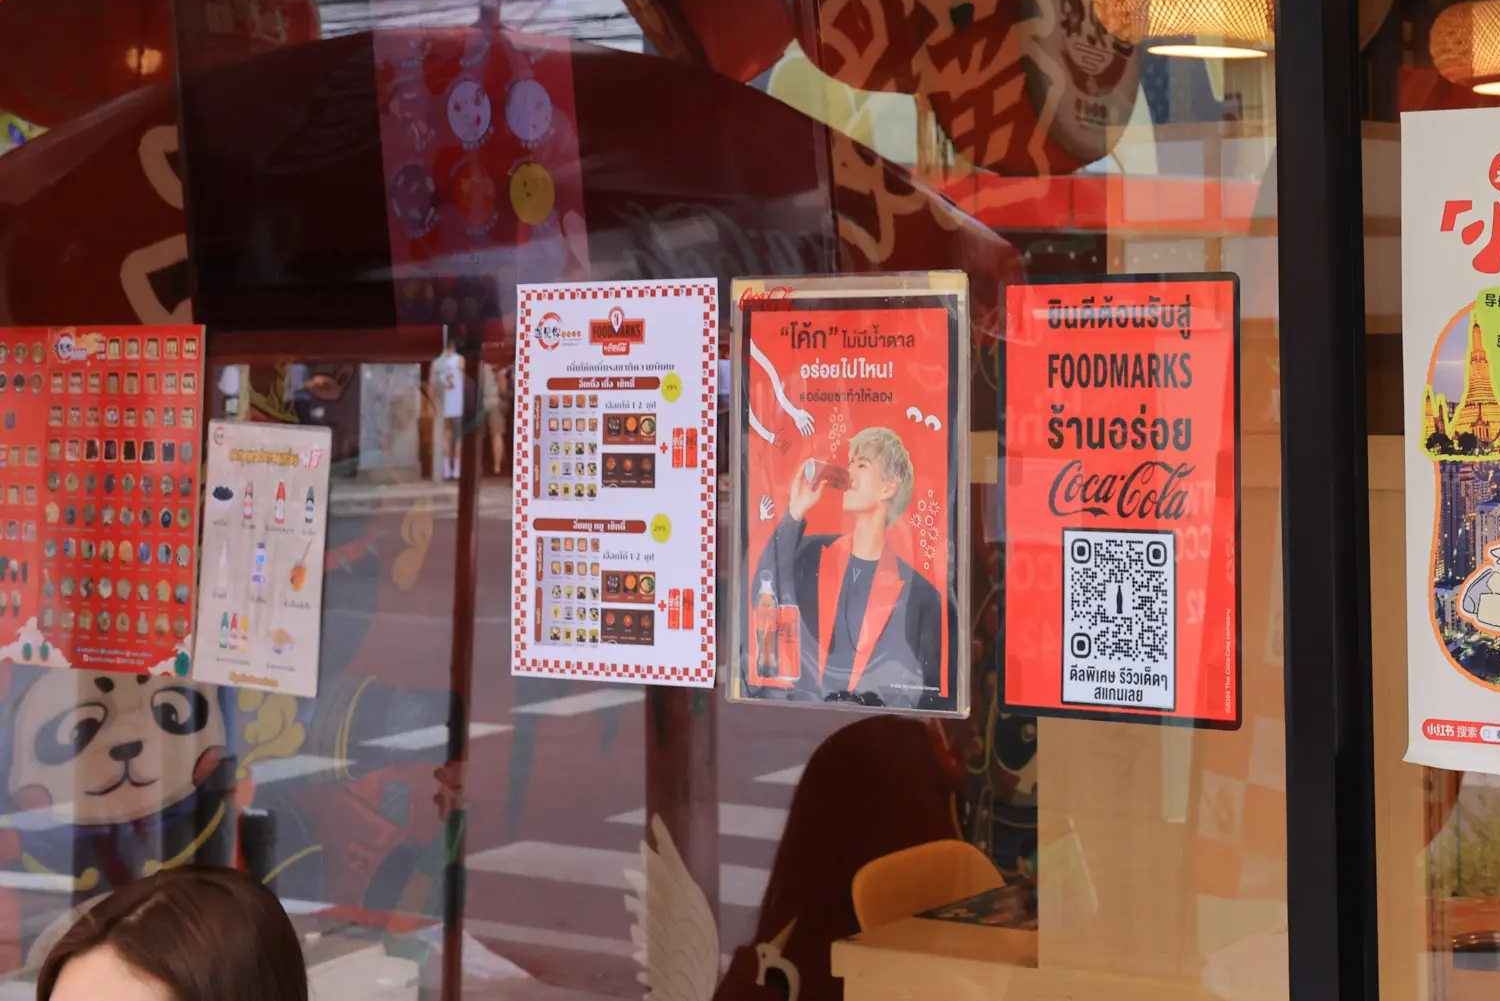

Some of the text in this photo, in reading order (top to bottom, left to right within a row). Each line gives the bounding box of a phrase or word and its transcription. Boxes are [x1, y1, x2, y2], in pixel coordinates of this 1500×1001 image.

[1048, 294, 1192, 340] ยินดีต้อนรับสู่
[841, 324, 915, 349] ไม่มีน้ำตาล
[1048, 352, 1193, 389] FOODMARKS
[1048, 404, 1193, 451] ร้านอร่อย
[1048, 460, 1197, 521] Coca-Cola
[1069, 664, 1168, 691] ดีลพิเศษ รีวิวเด็ดๆ
[1094, 684, 1143, 703] สแกนเลย
[1427, 723, 1455, 738] 小红书
